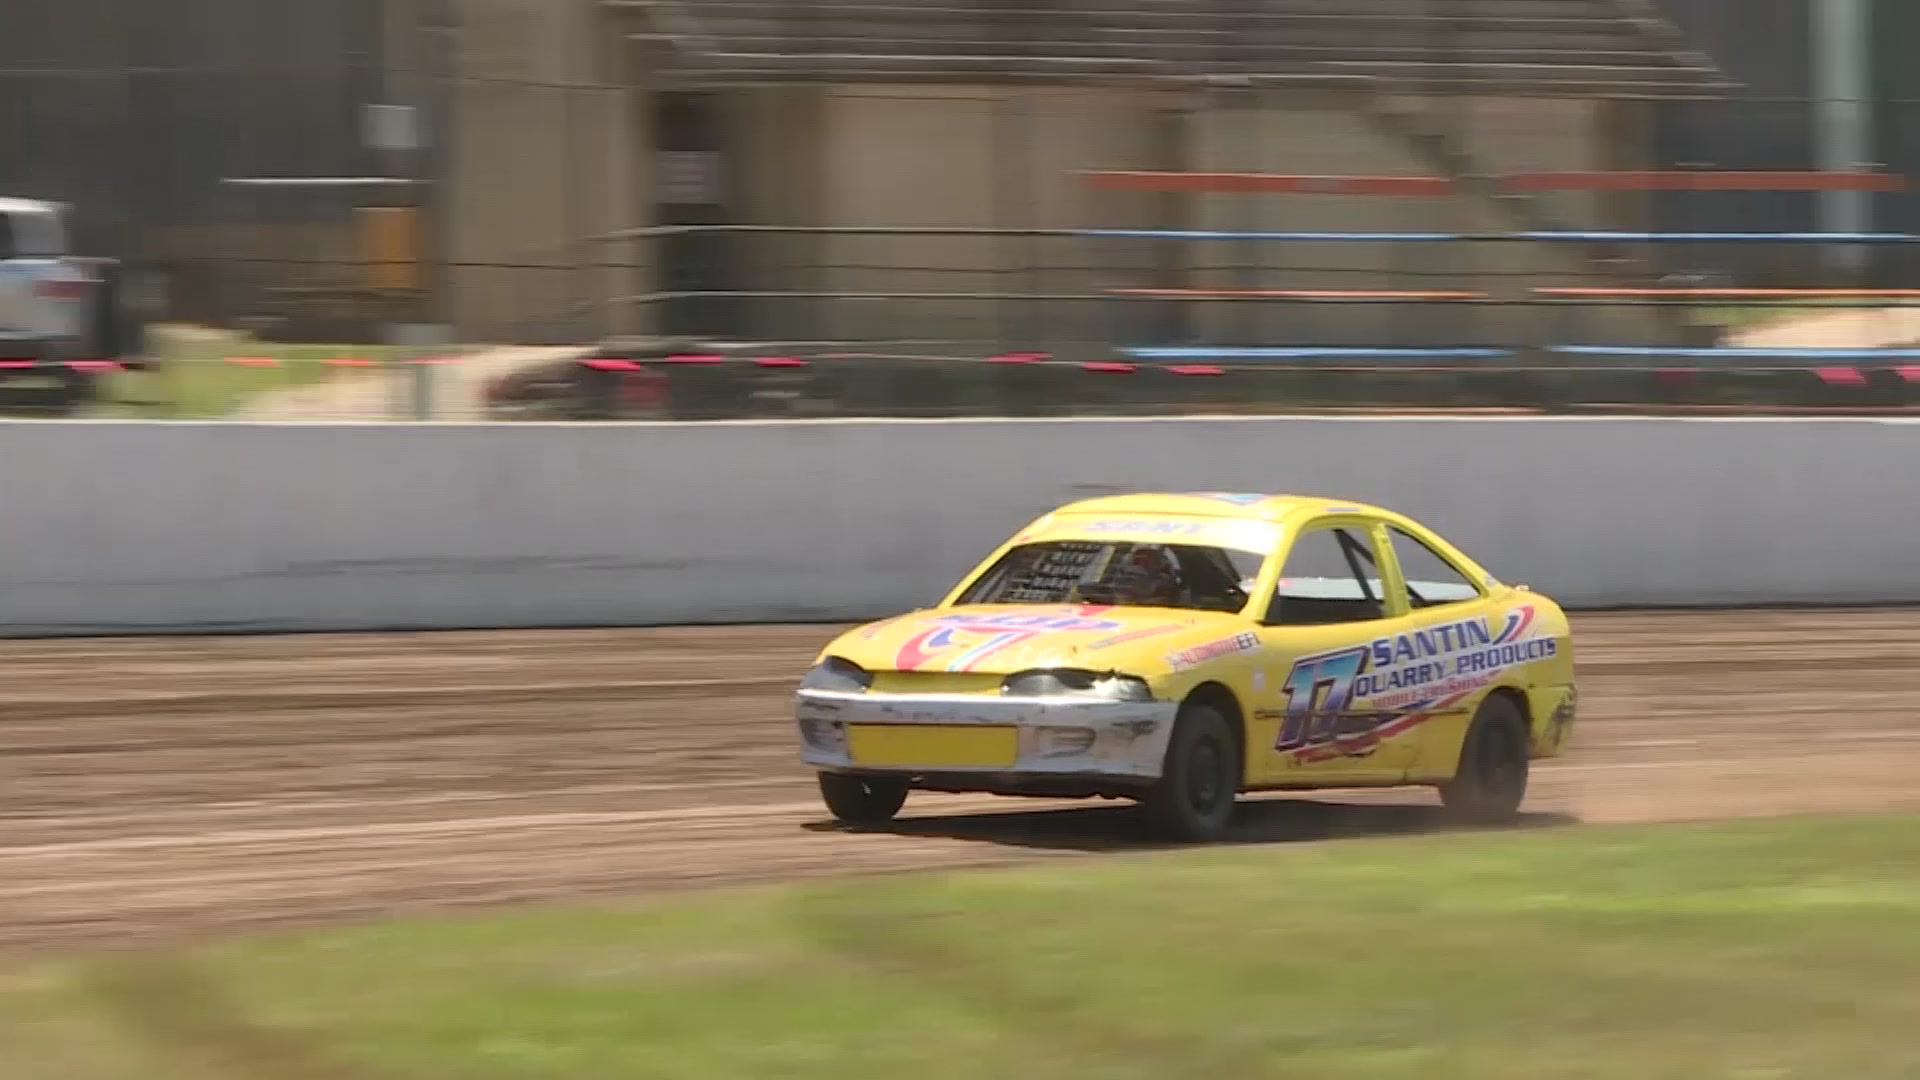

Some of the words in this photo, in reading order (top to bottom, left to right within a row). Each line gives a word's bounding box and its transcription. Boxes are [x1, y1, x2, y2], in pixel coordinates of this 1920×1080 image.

[1355, 660, 1446, 697] QUARRY
[1456, 637, 1556, 676] PRODUCTS
[1372, 616, 1491, 668] SANTIN
[1275, 645, 1371, 751] 17
